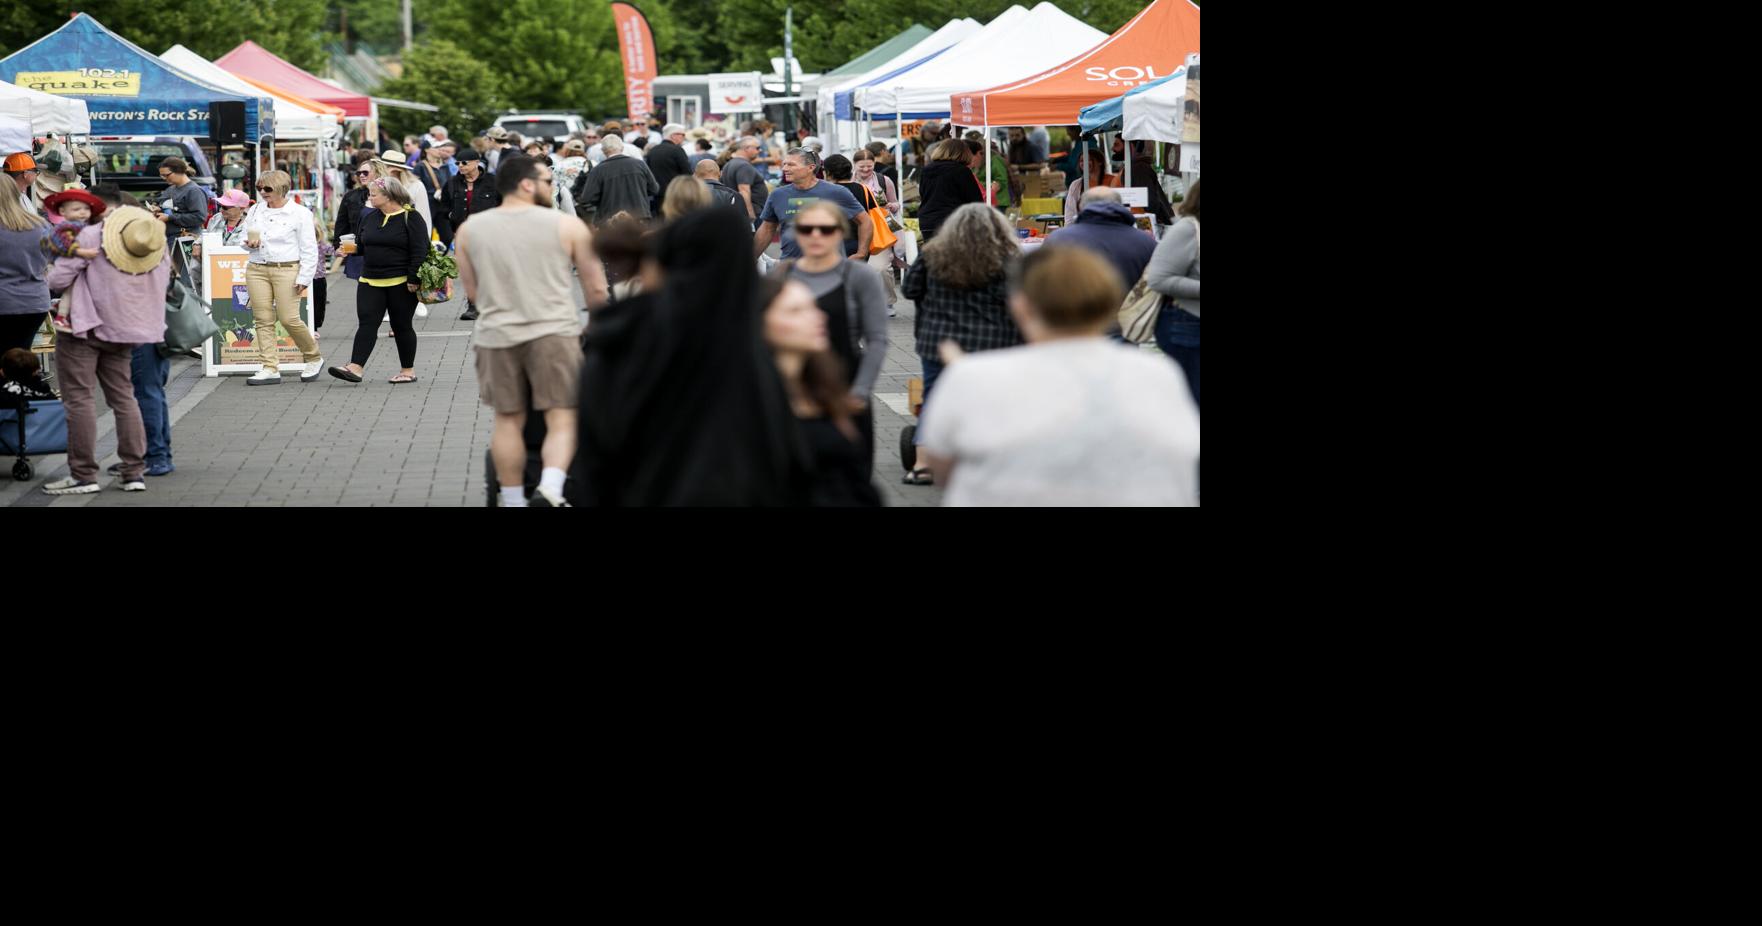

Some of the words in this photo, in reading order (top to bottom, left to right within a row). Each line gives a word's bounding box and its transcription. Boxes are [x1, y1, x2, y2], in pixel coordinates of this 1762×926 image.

[79, 67, 129, 78] 102.1
[28, 80, 129, 91] quake
[147, 108, 185, 121] ROCK
[217, 260, 241, 269] WE
